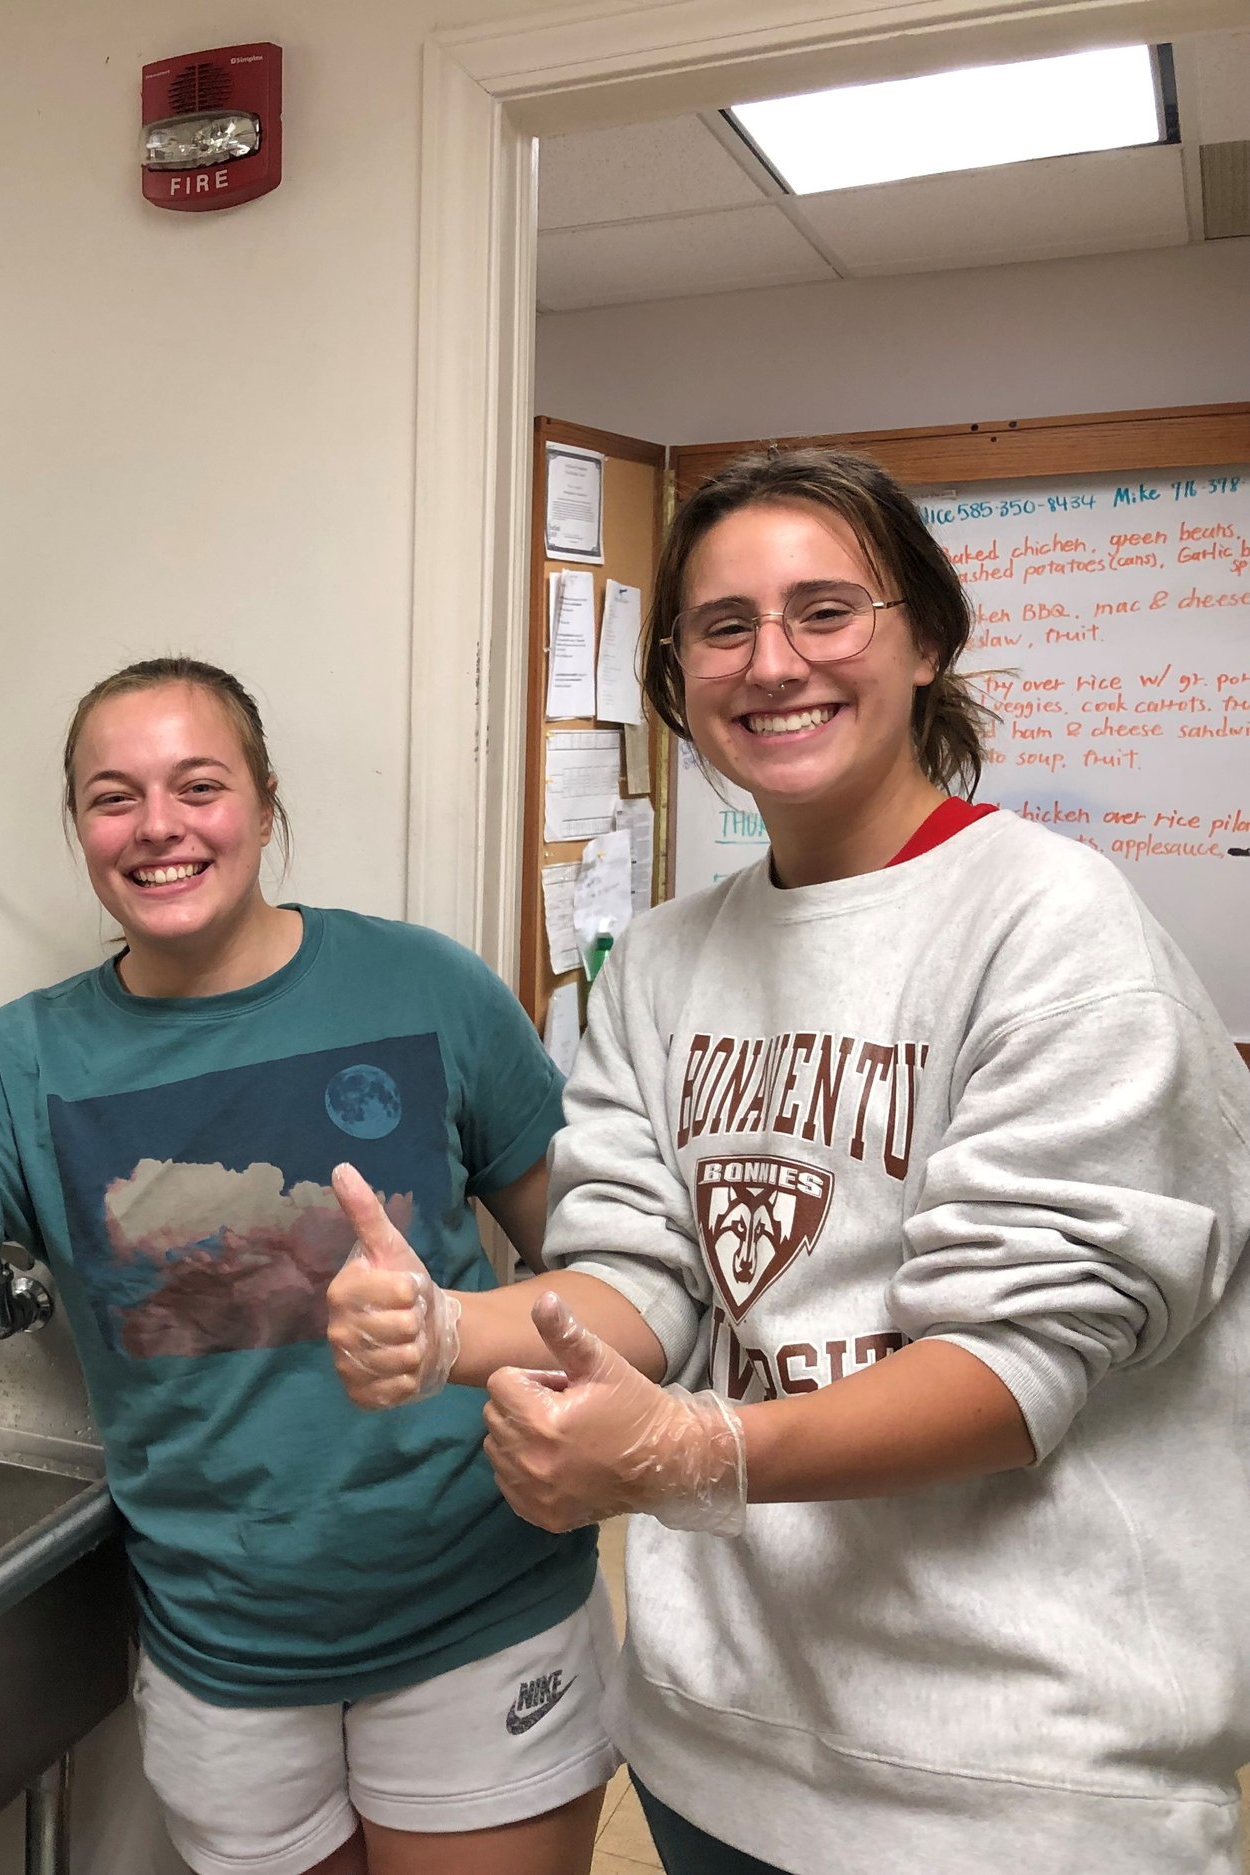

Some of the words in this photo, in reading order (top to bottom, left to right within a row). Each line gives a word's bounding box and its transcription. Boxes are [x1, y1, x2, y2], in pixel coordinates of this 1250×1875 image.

[170, 169, 229, 195] FIRE
[1113, 482, 1161, 508] Mike
[1110, 528, 1168, 549] green
[959, 558, 1014, 583] ashed
[1178, 542, 1233, 564] Garlic
[1241, 539, 1250, 557] b
[1230, 559, 1248, 576] sp
[977, 603, 1010, 624] ken
[1094, 598, 1141, 617] mac
[1149, 590, 1169, 610] &
[1178, 587, 1250, 610] cheese
[1023, 679, 1065, 692] over
[1076, 674, 1122, 691] rice
[1139, 663, 1171, 688] w/
[1217, 672, 1250, 692] por
[1081, 694, 1128, 713] cook
[1012, 721, 1052, 739] ham
[1066, 721, 1083, 738] &
[1091, 716, 1164, 737] cheese
[1178, 716, 1250, 738] sandwi
[1103, 811, 1146, 824] over
[1154, 810, 1200, 828] rice
[703, 1161, 824, 1198] BONNIES
[517, 1669, 562, 1711] NIKE
